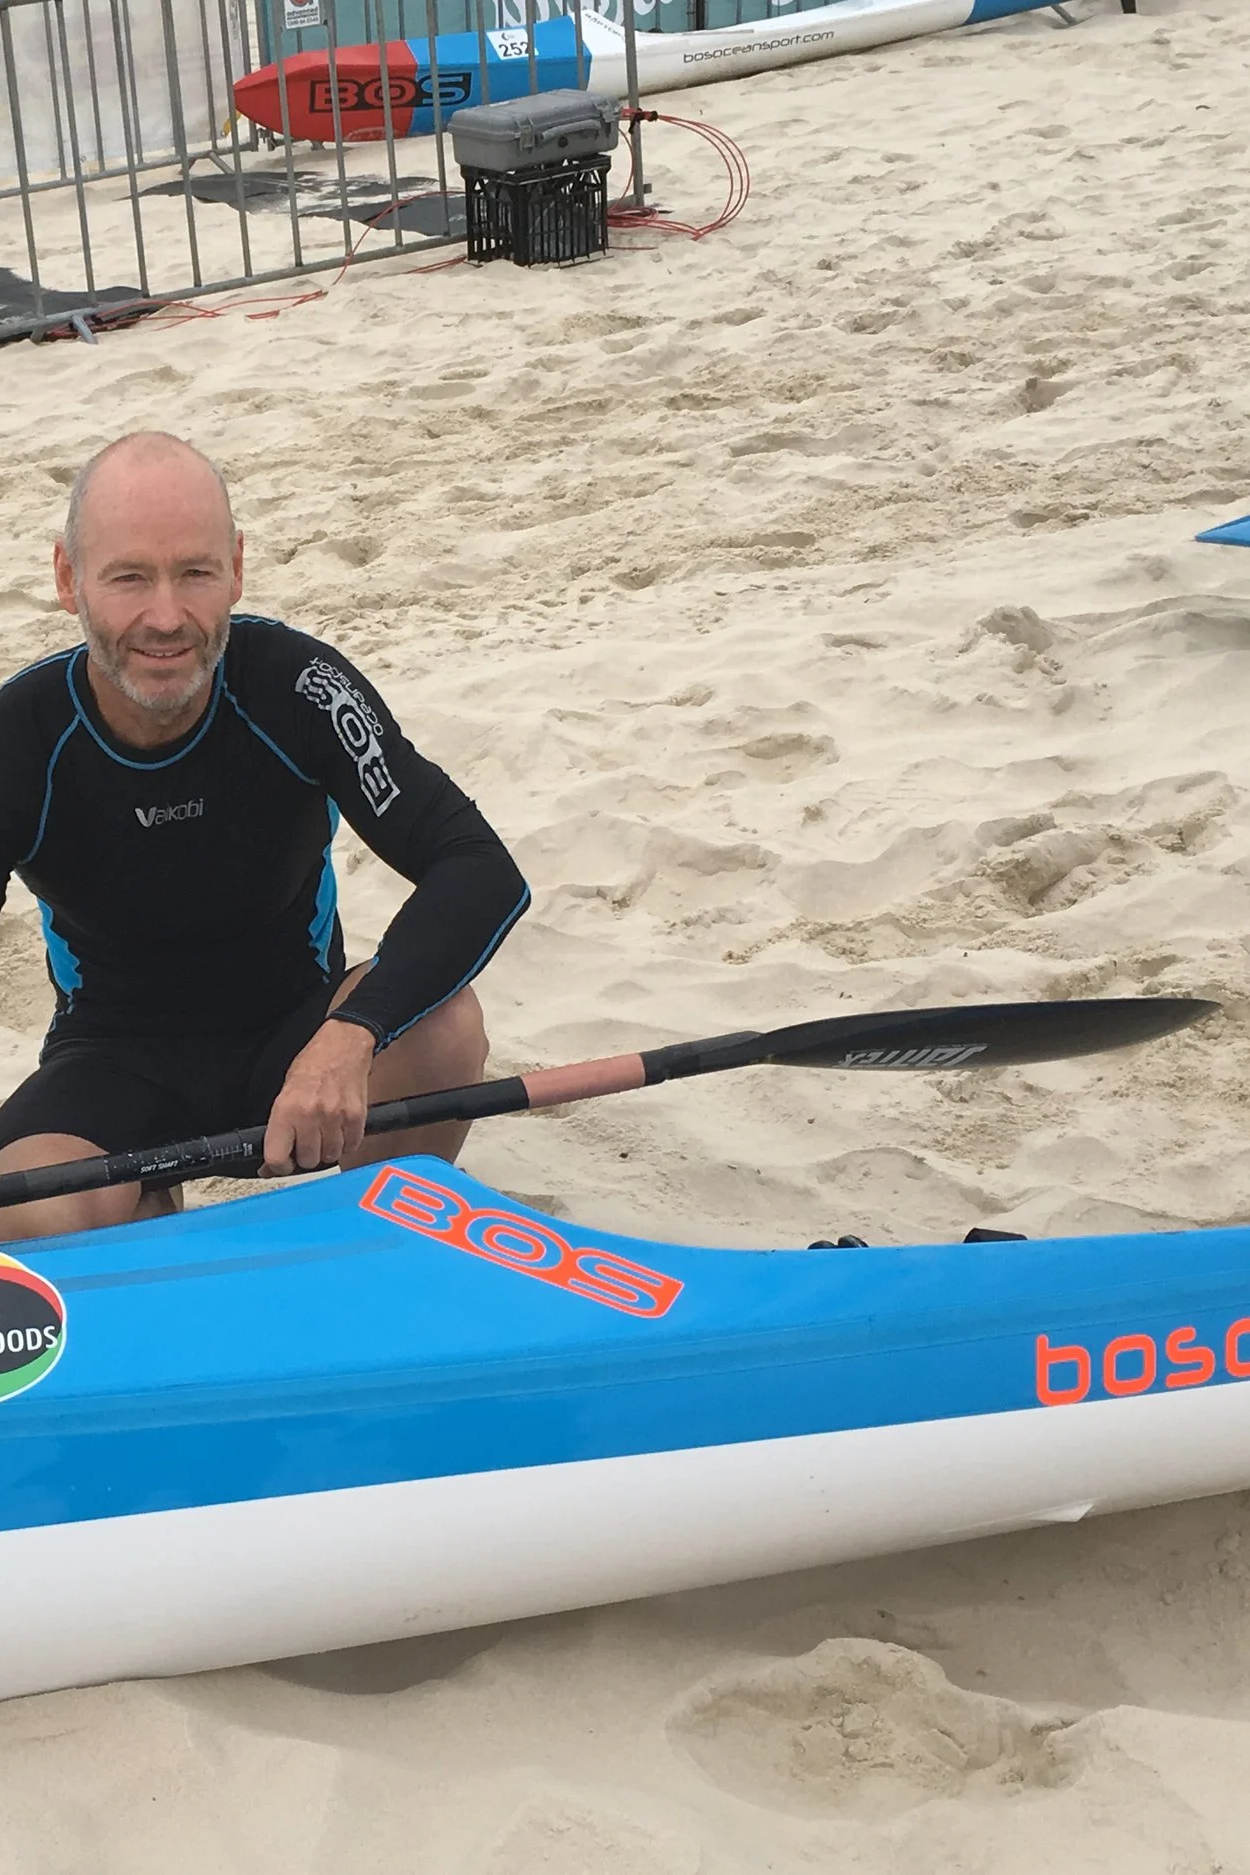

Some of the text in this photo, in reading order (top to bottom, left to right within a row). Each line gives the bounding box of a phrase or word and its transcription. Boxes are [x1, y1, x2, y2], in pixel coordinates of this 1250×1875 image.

[499, 41, 529, 57] 252
[683, 31, 834, 63] bosoceansport.com
[312, 73, 469, 111] BOS
[303, 668, 396, 813] BOS
[134, 798, 204, 827] Vaikobi
[368, 1170, 666, 1314] BOS
